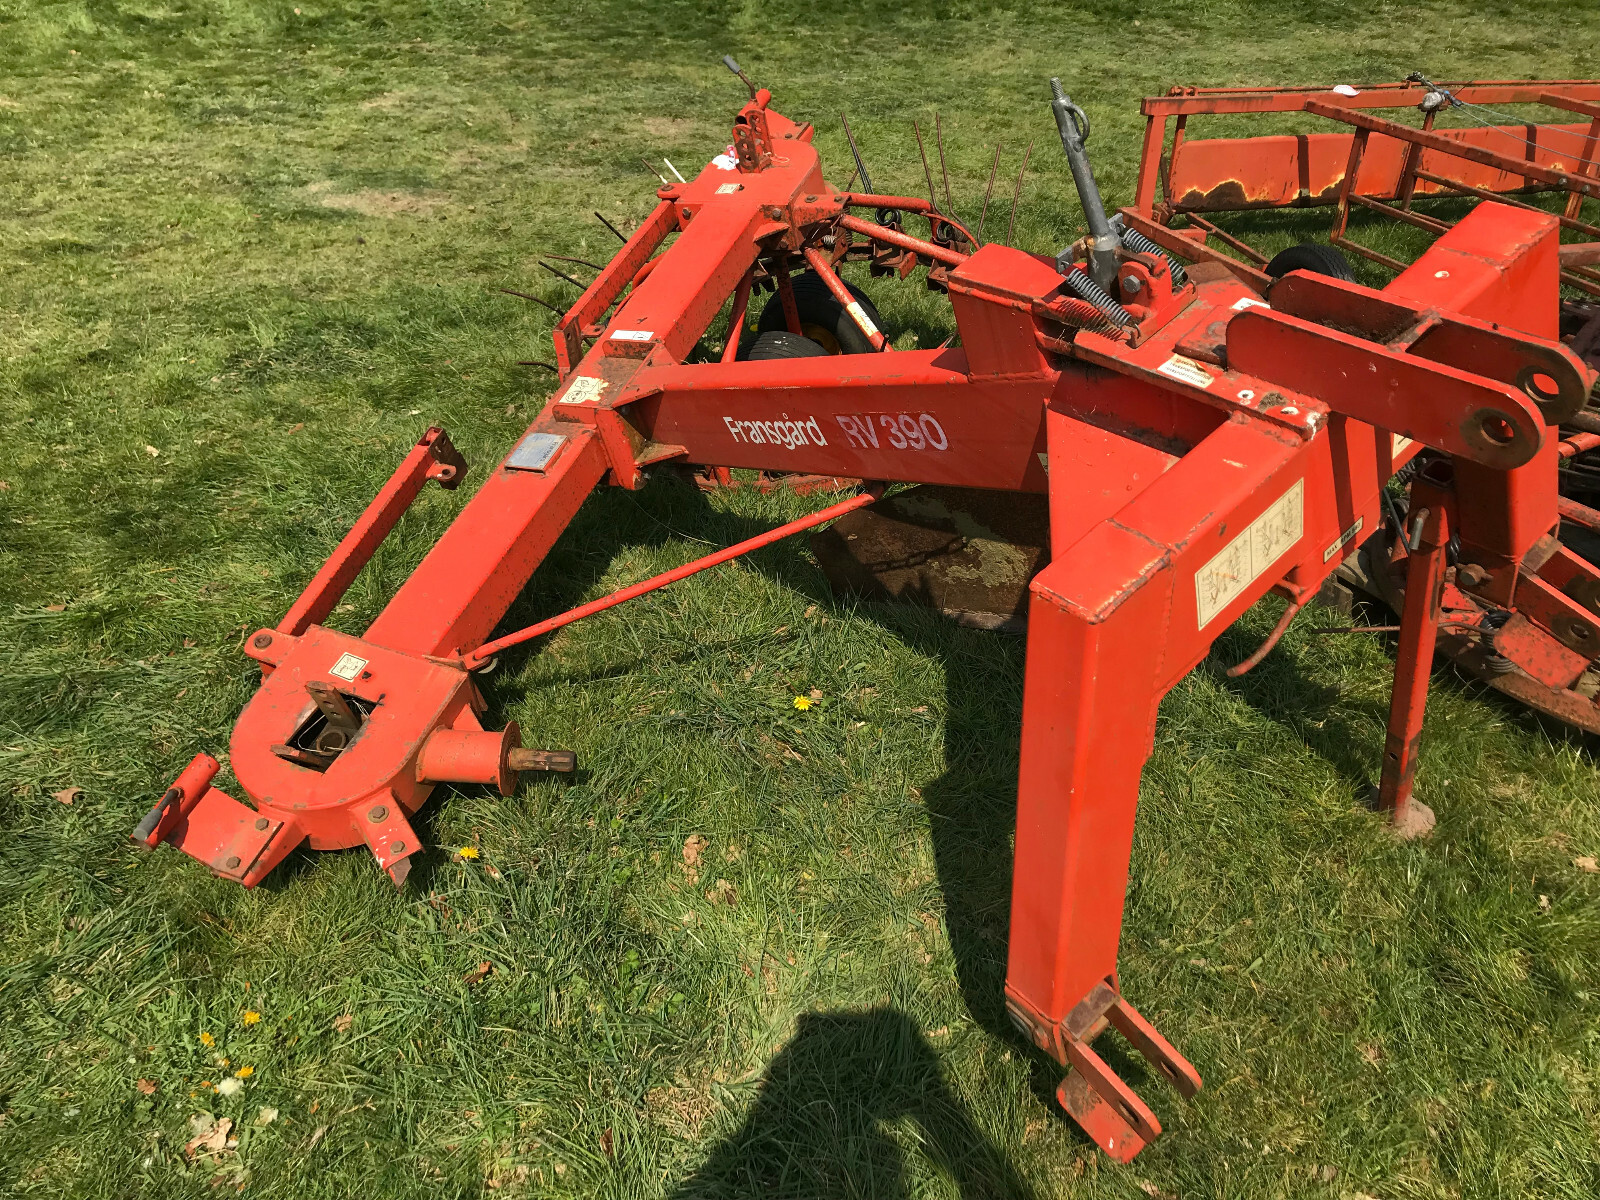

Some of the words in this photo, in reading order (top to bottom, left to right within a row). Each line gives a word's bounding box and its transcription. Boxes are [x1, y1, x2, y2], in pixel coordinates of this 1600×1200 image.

[722, 412, 829, 451] Fransgård
[835, 415, 880, 449] RV
[880, 413, 949, 451] 390
